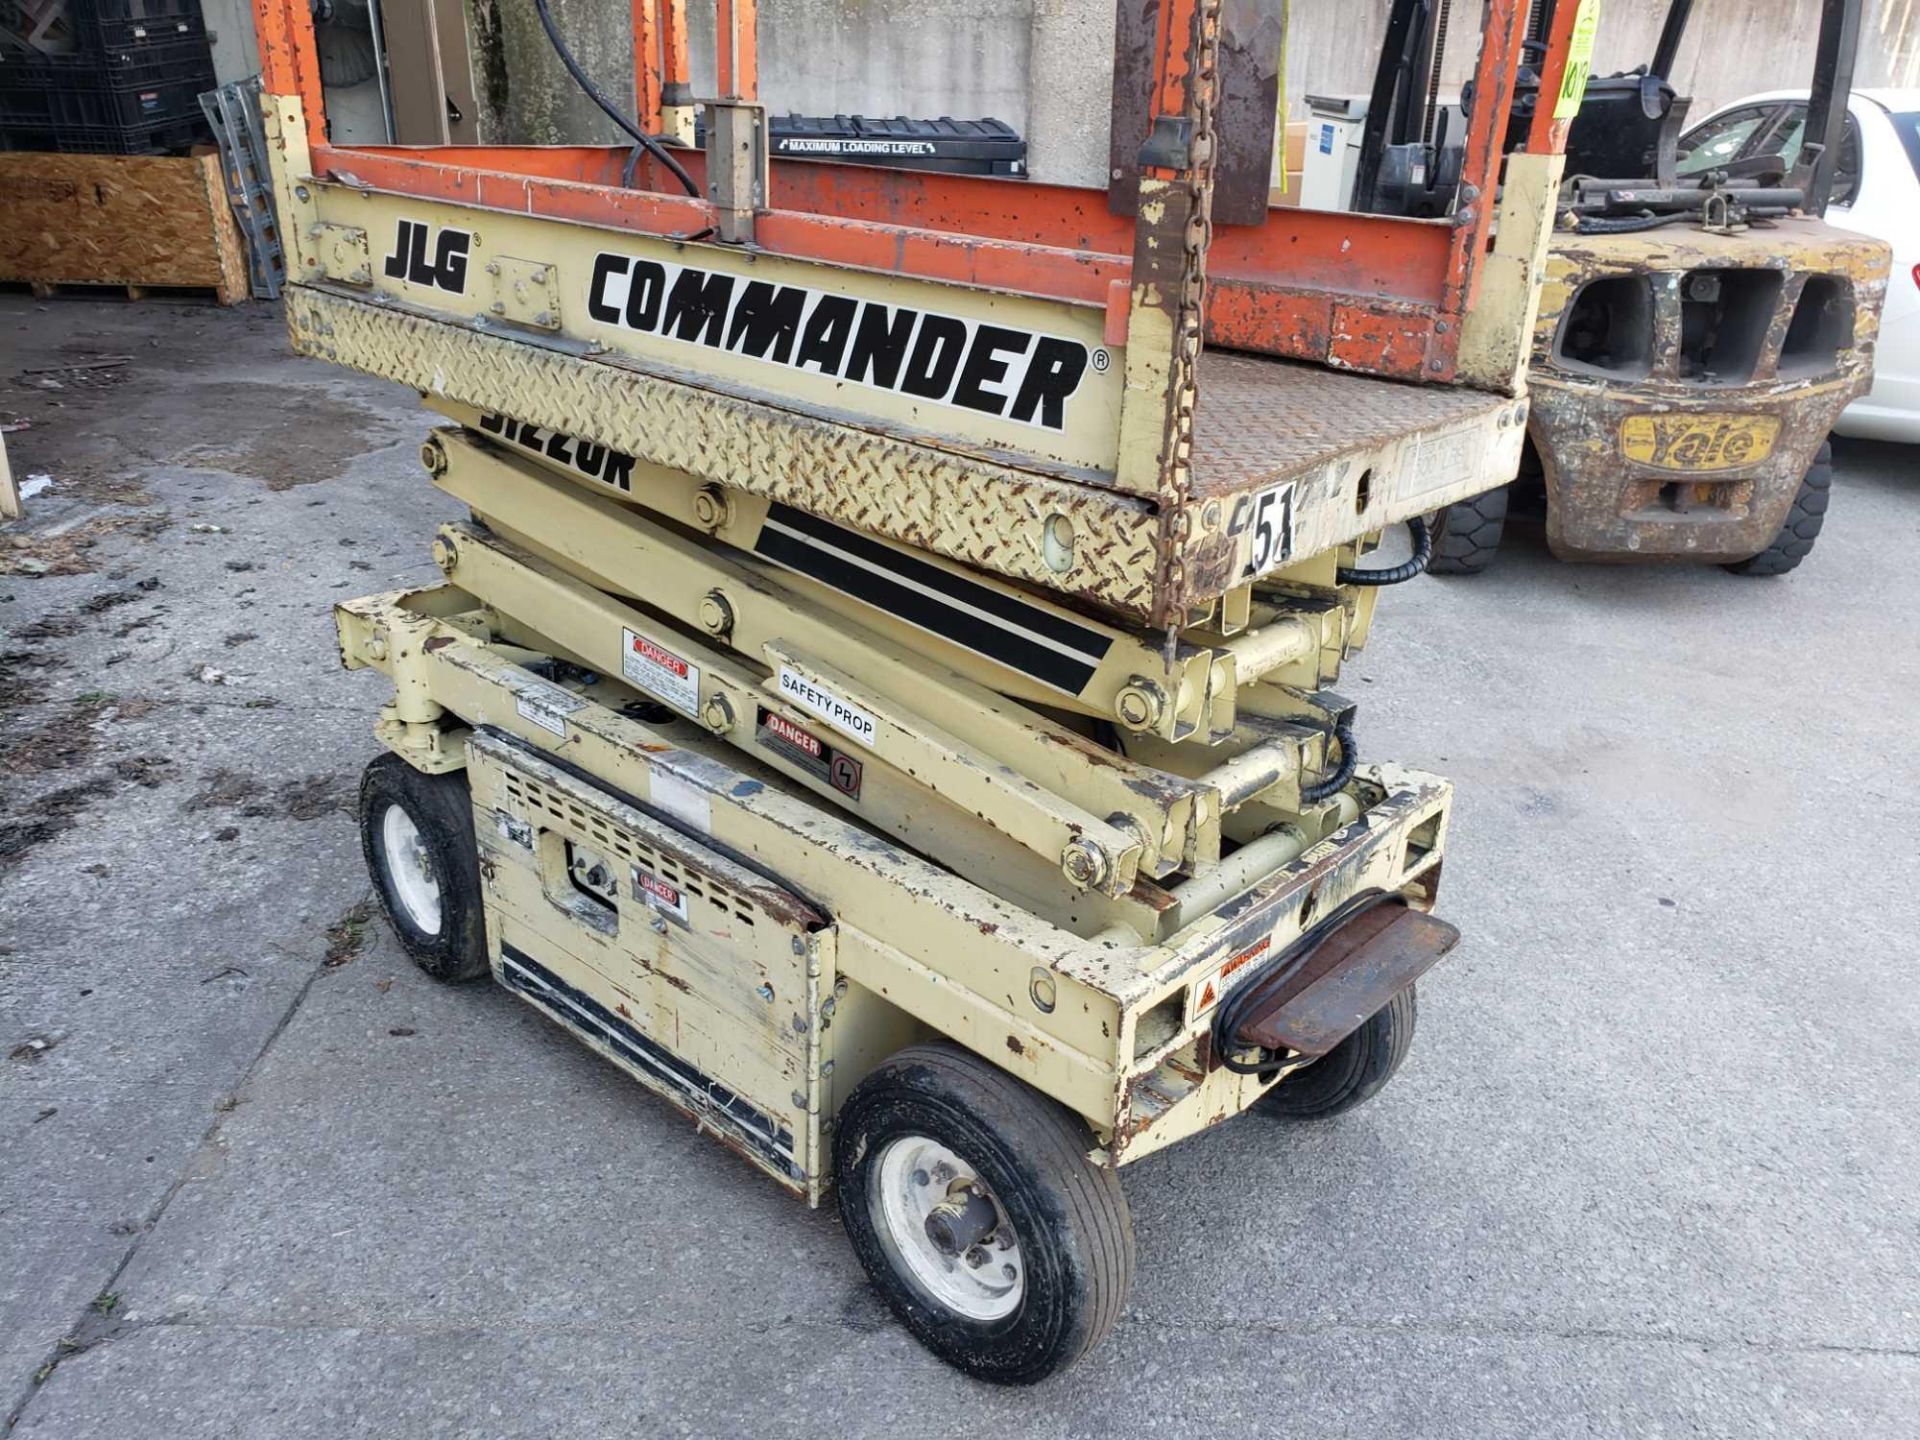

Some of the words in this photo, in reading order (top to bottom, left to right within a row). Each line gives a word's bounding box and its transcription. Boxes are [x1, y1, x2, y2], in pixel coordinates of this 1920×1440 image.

[789, 140, 840, 152] MAXIMUM
[843, 142, 890, 154] LOADING
[892, 143, 925, 155] LEVEL
[384, 219, 471, 295] JLG
[588, 252, 1089, 430] COMMANDER
[641, 642, 680, 675] DANGER
[781, 673, 832, 713] SAFETY
[833, 704, 873, 735] PROP
[768, 714, 819, 756] DANGER
